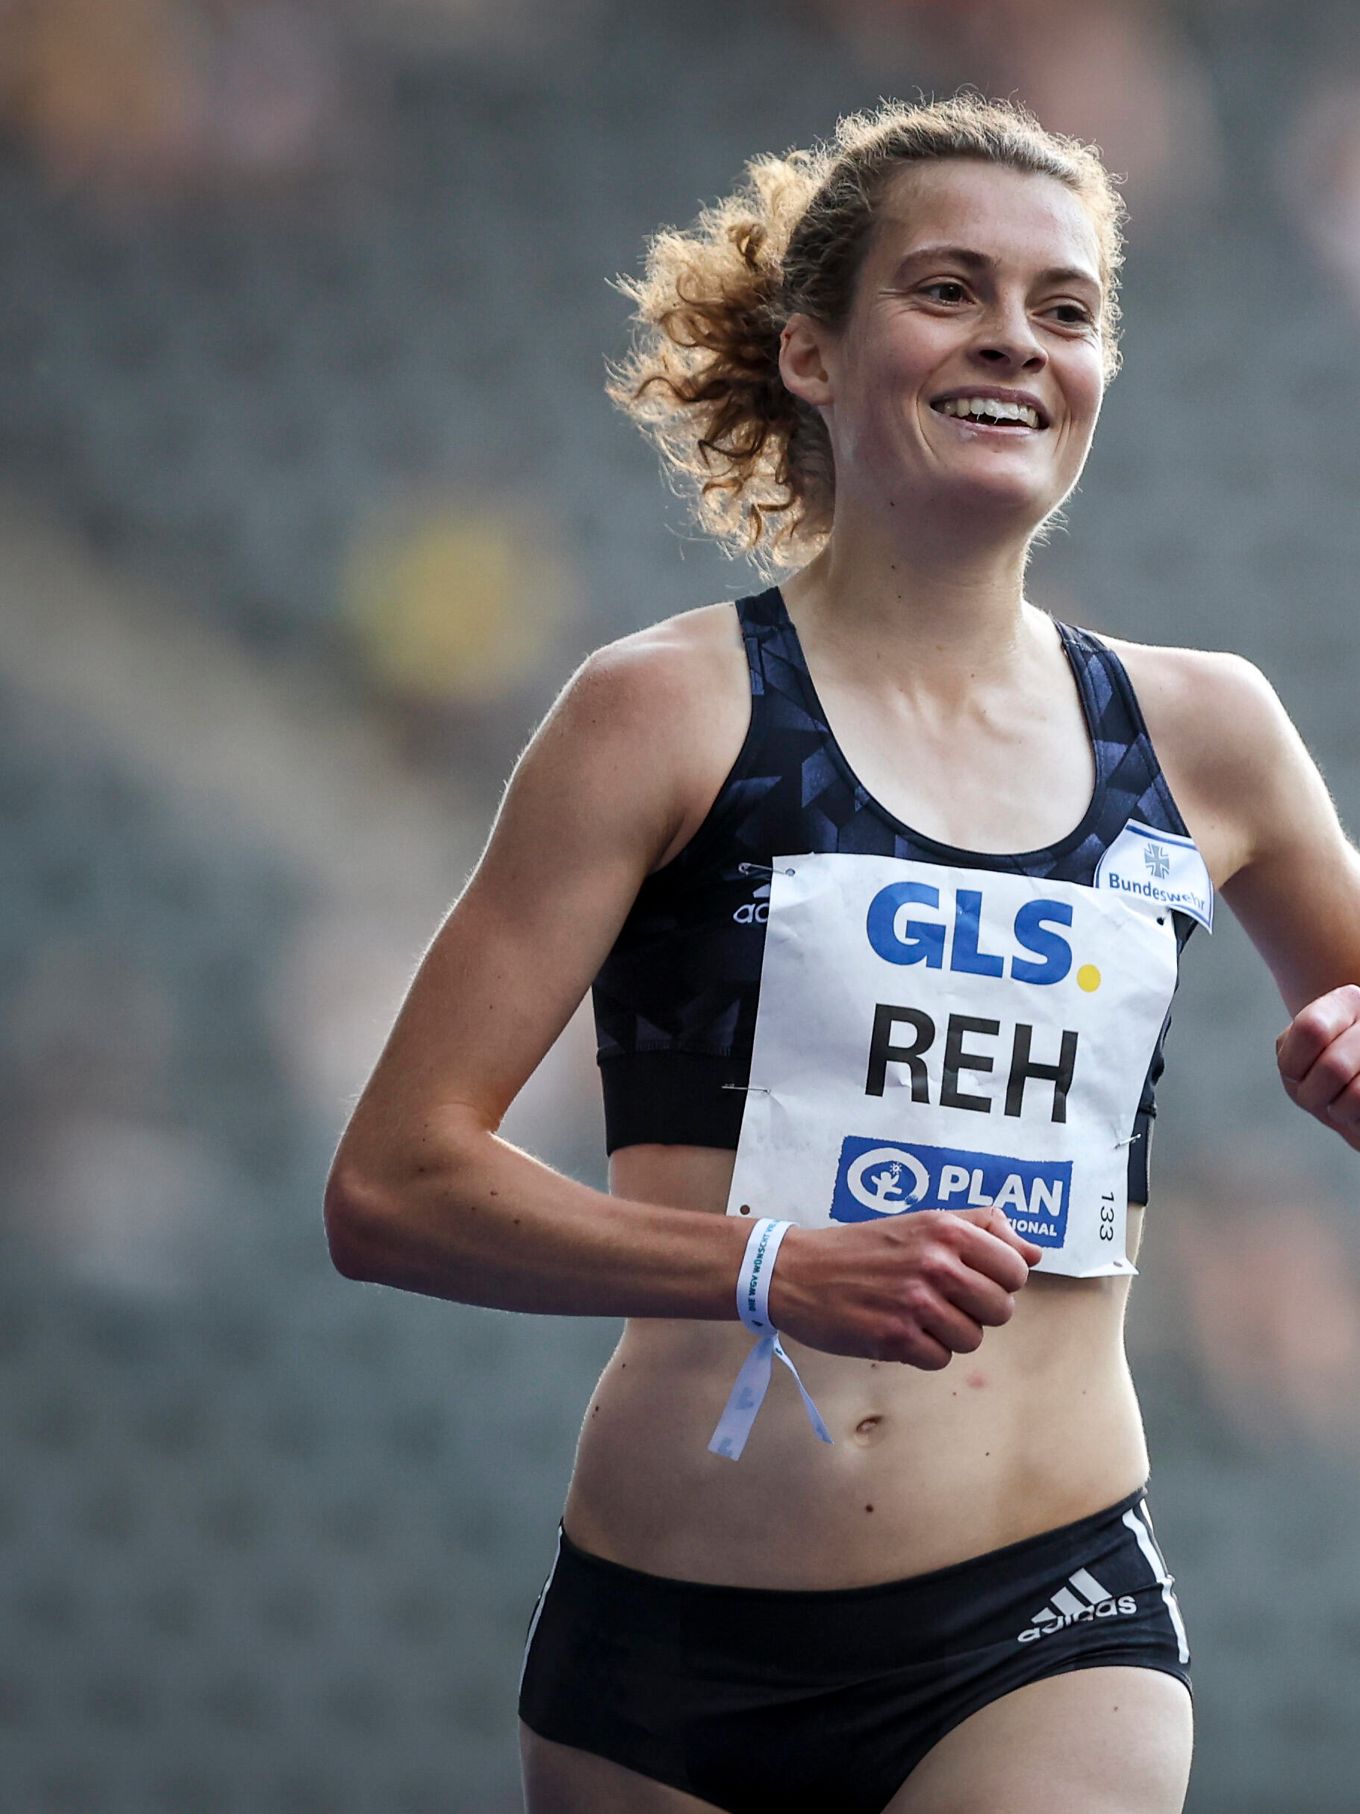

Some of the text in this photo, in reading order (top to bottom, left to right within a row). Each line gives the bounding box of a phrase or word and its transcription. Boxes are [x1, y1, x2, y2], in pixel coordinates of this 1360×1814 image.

[865, 1003, 1079, 1124] REH
[937, 1164, 1063, 1217] PLAN
[1099, 1191, 1115, 1242] 133
